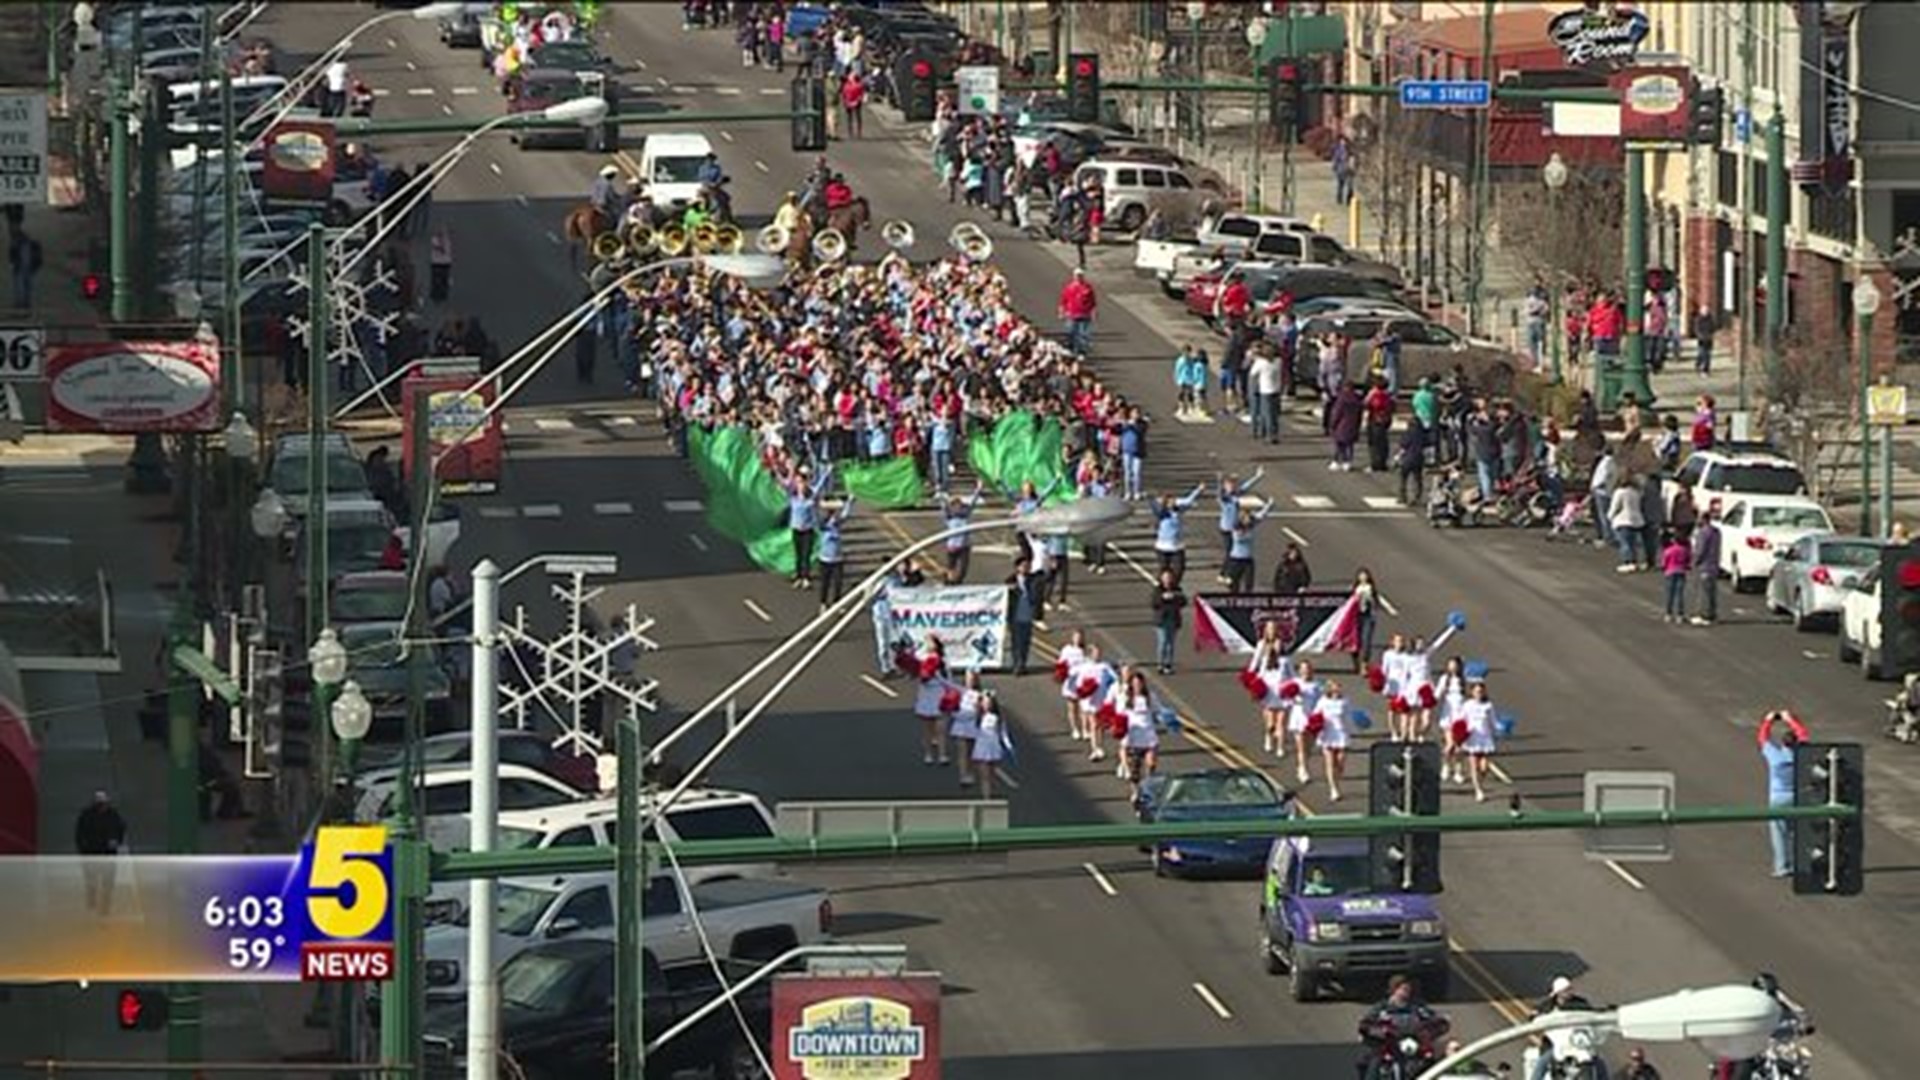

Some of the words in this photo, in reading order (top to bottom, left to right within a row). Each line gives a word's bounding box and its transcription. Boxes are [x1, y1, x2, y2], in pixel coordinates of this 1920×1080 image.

[1567, 43, 1634, 64] Room
[1407, 86, 1432, 101] 9TH
[1439, 86, 1485, 101] STREET
[890, 609, 1002, 628] MAVERICK
[797, 1033, 917, 1055] DOWNTOWN
